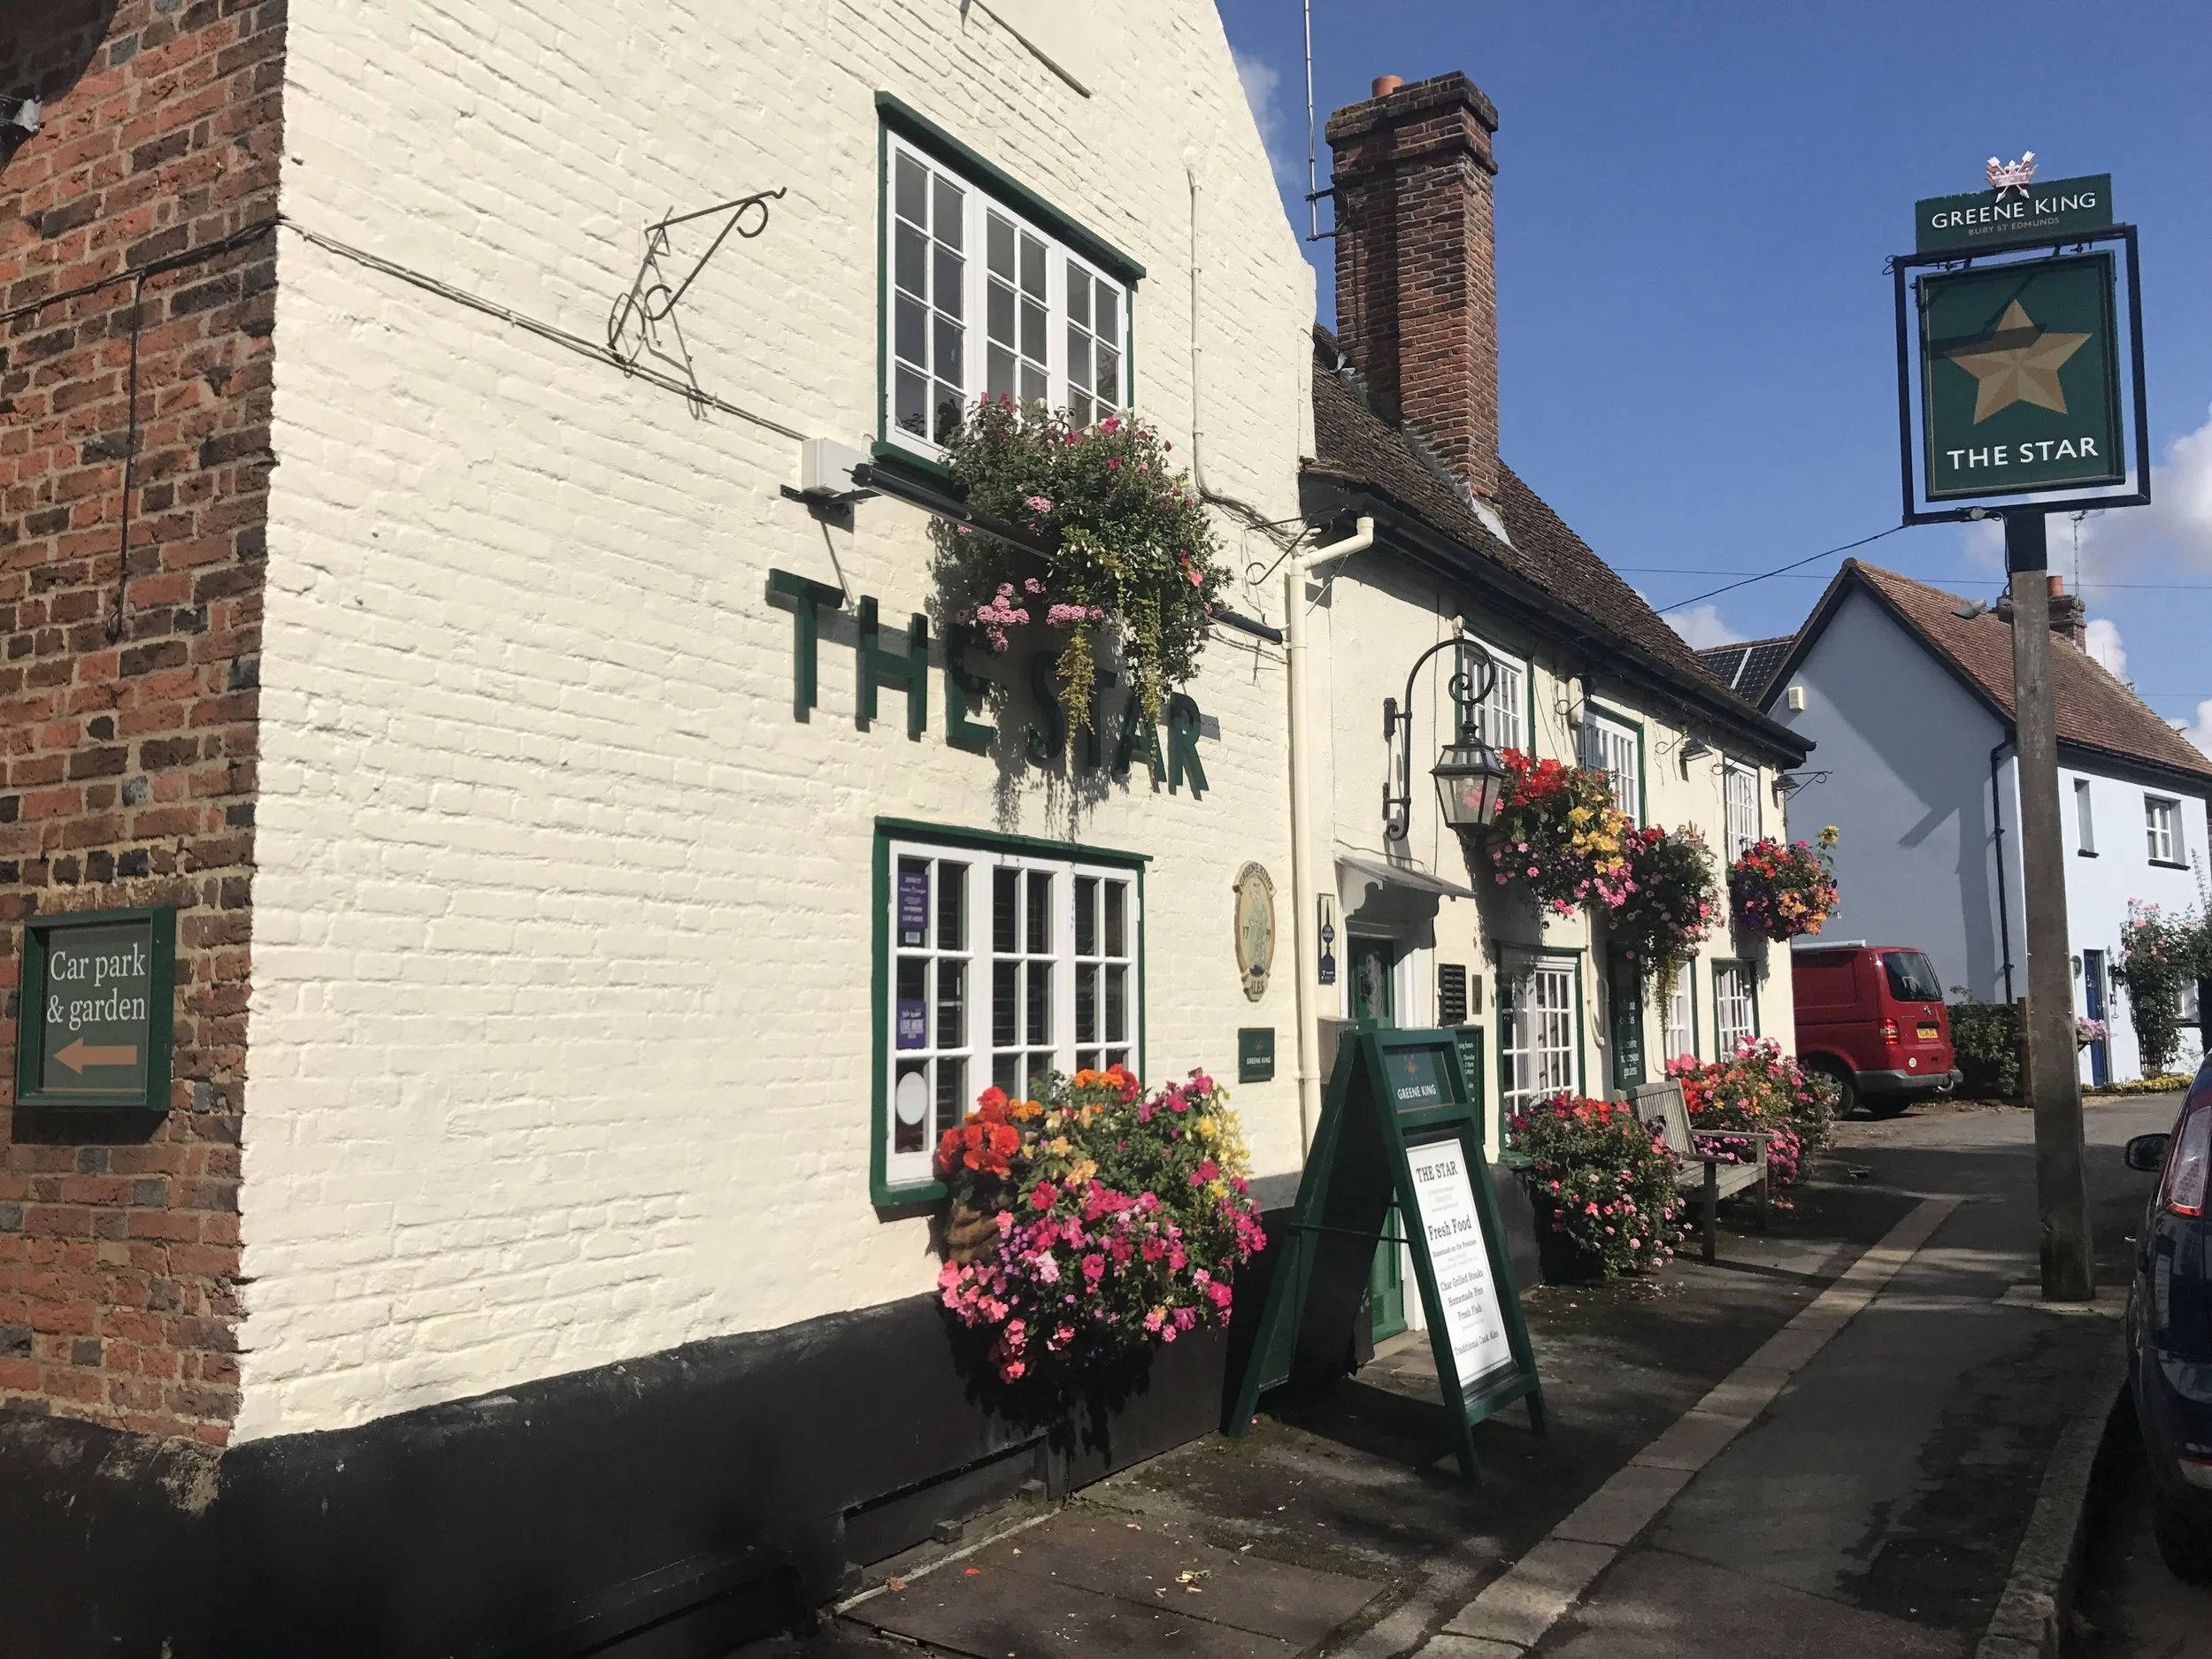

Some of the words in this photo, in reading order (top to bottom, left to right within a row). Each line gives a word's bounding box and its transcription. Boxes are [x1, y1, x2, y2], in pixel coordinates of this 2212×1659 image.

[1932, 202, 2024, 228] GREENE
[2035, 192, 2096, 215] KING
[1968, 225, 1994, 235] BURY
[1996, 223, 2008, 233] ST
[2011, 217, 2060, 230] EDMUNDS
[1947, 445, 2008, 470] THE
[2020, 437, 2099, 464] STAR
[766, 568, 995, 750] THE
[50, 951, 88, 981] Car
[94, 942, 146, 987] park
[47, 995, 65, 1023] &
[69, 987, 146, 1031] garden
[1397, 1086, 1421, 1100] GREENE
[1420, 1083, 1437, 1096] KING
[1416, 1164, 1435, 1183] THE
[1435, 1161, 1458, 1179] STAR
[1427, 1219, 1451, 1241] Fresh
[1451, 1214, 1472, 1234] Food
[1440, 1280, 1452, 1292] Char
[1452, 1273, 1469, 1288] Grilled
[1469, 1269, 1484, 1282] Steaks
[1448, 1290, 1474, 1307] Homemade
[1474, 1286, 1484, 1298] Pies
[1457, 1310, 1471, 1322] Fresh
[1471, 1303, 1483, 1316] Fish
[1454, 1337, 1479, 1356] Traditional
[1479, 1333, 1489, 1345] Cask
[1489, 1329, 1500, 1340] Ales
